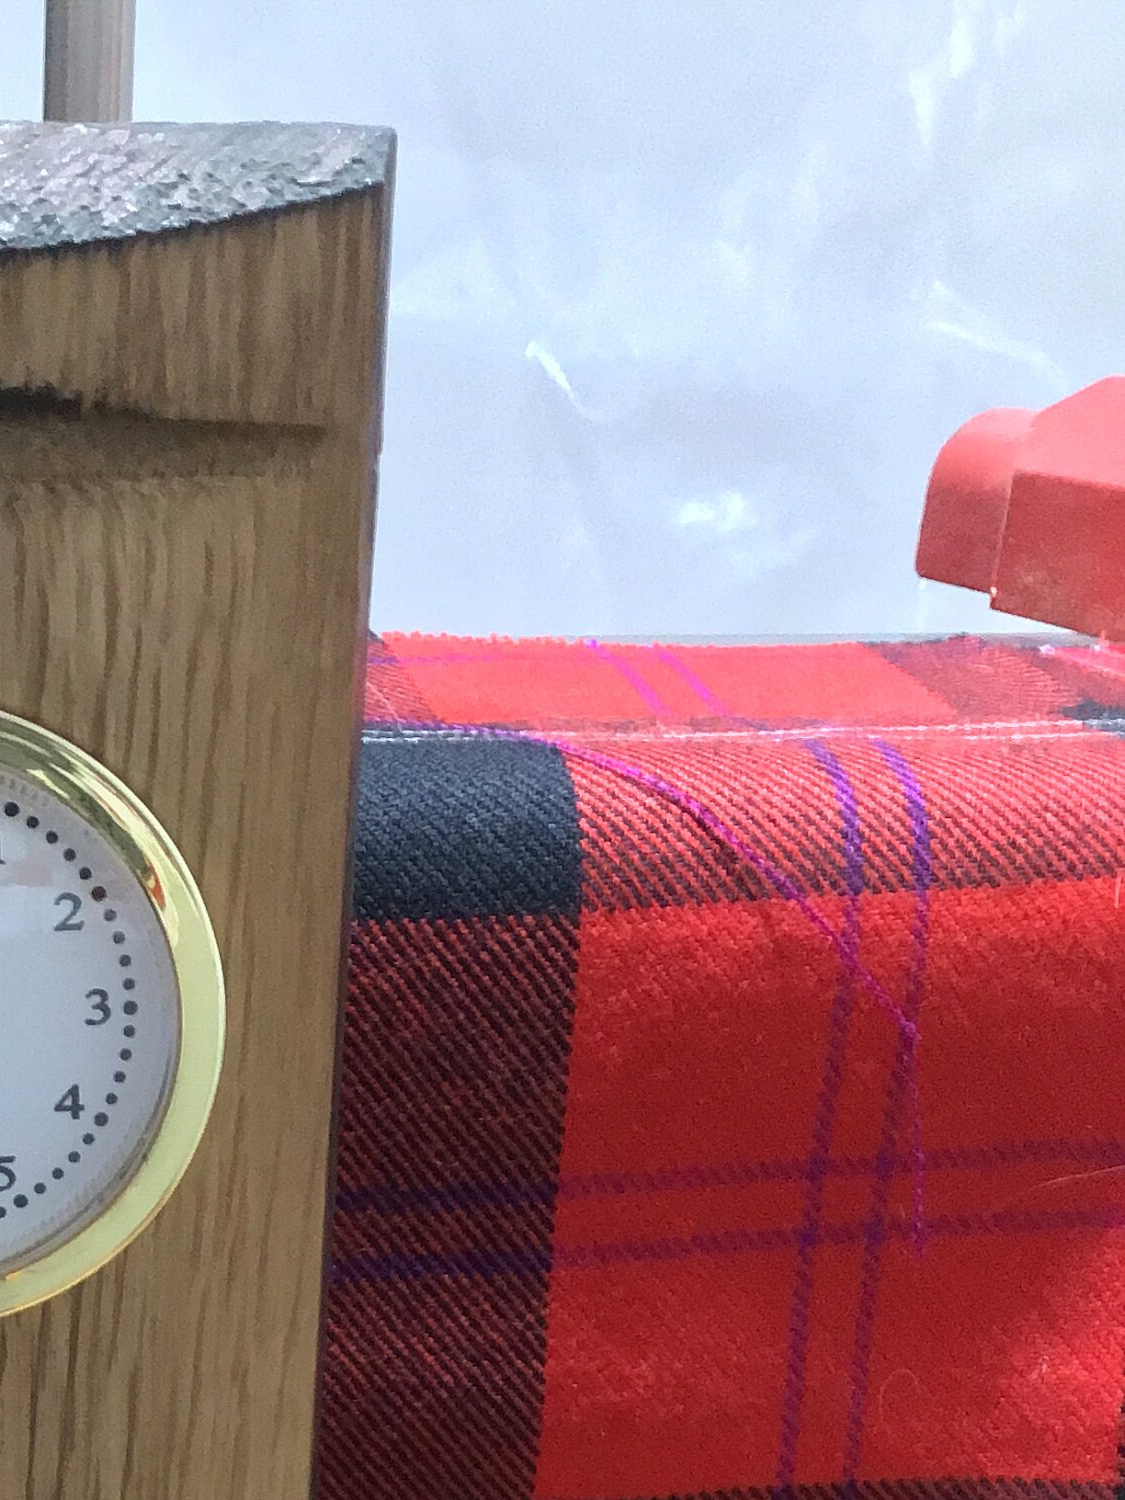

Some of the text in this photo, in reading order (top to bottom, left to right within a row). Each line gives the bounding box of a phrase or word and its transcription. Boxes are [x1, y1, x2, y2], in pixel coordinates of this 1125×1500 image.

[53, 892, 86, 932] 2
[84, 988, 112, 1026] 3
[53, 1083, 86, 1121] 4
